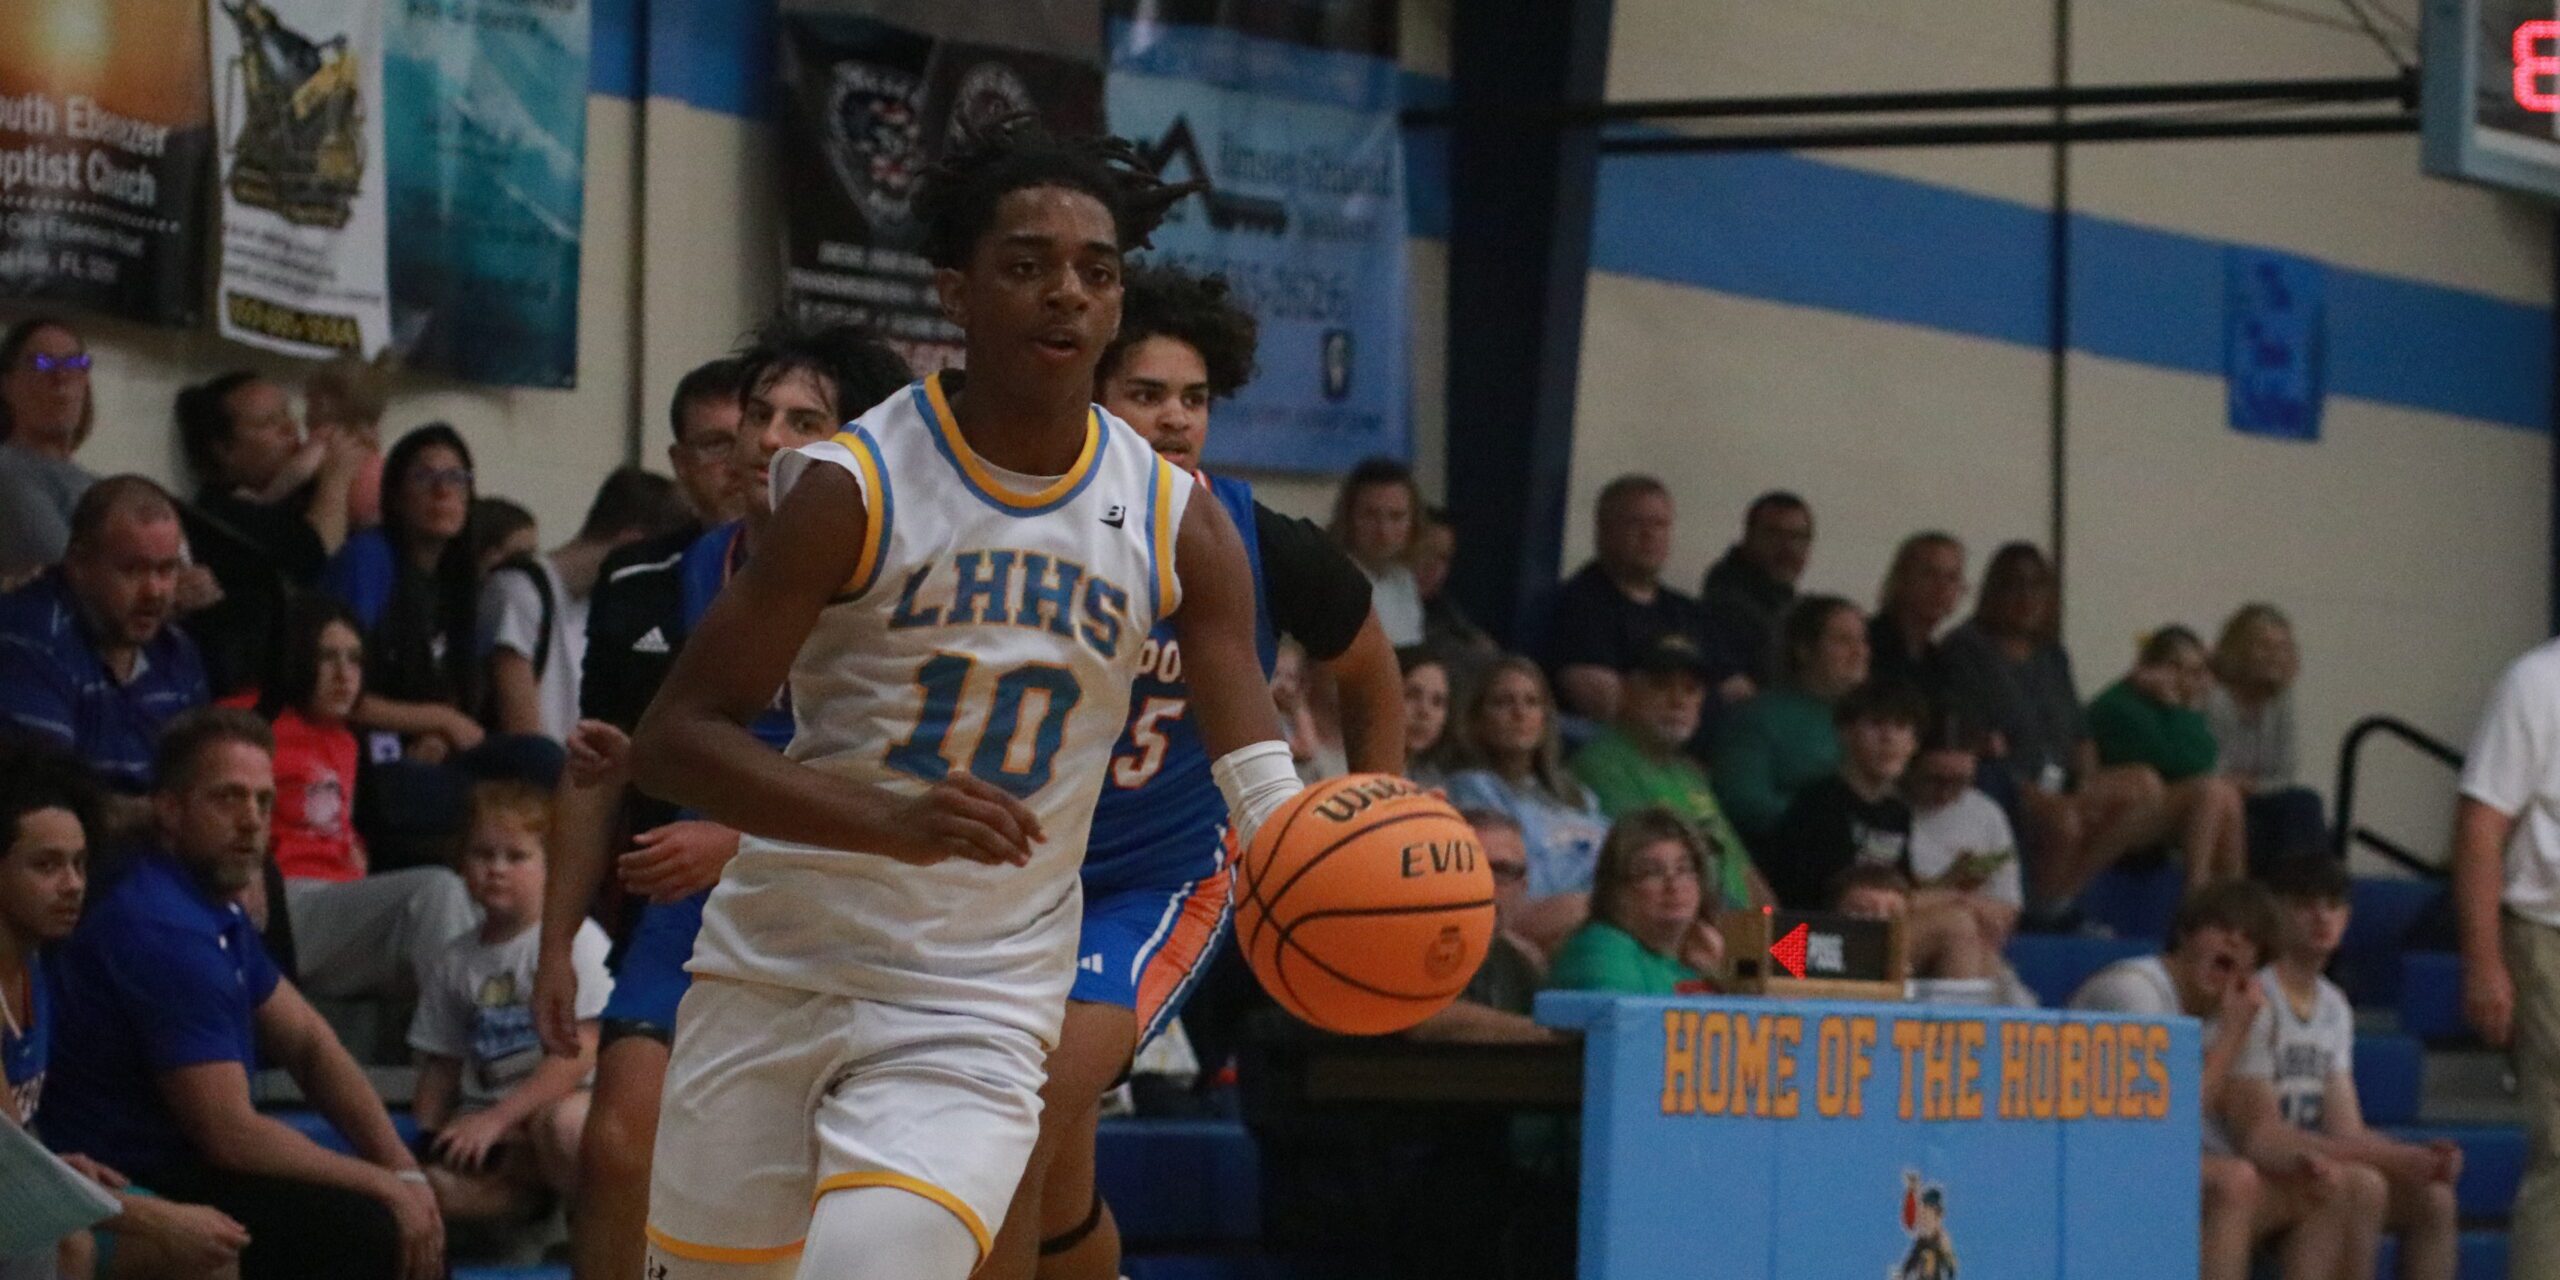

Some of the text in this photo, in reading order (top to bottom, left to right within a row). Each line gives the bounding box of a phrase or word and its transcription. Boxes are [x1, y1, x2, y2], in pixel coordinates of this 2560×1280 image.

[0, 144, 81, 191] ptist
[887, 547, 1128, 660] LHHS
[885, 650, 1082, 801] 10
[1660, 1009, 1803, 1119] HOME
[1815, 1015, 1877, 1119] OF
[1892, 1018, 1986, 1120] THE
[1997, 1021, 2172, 1120] HOBOES
